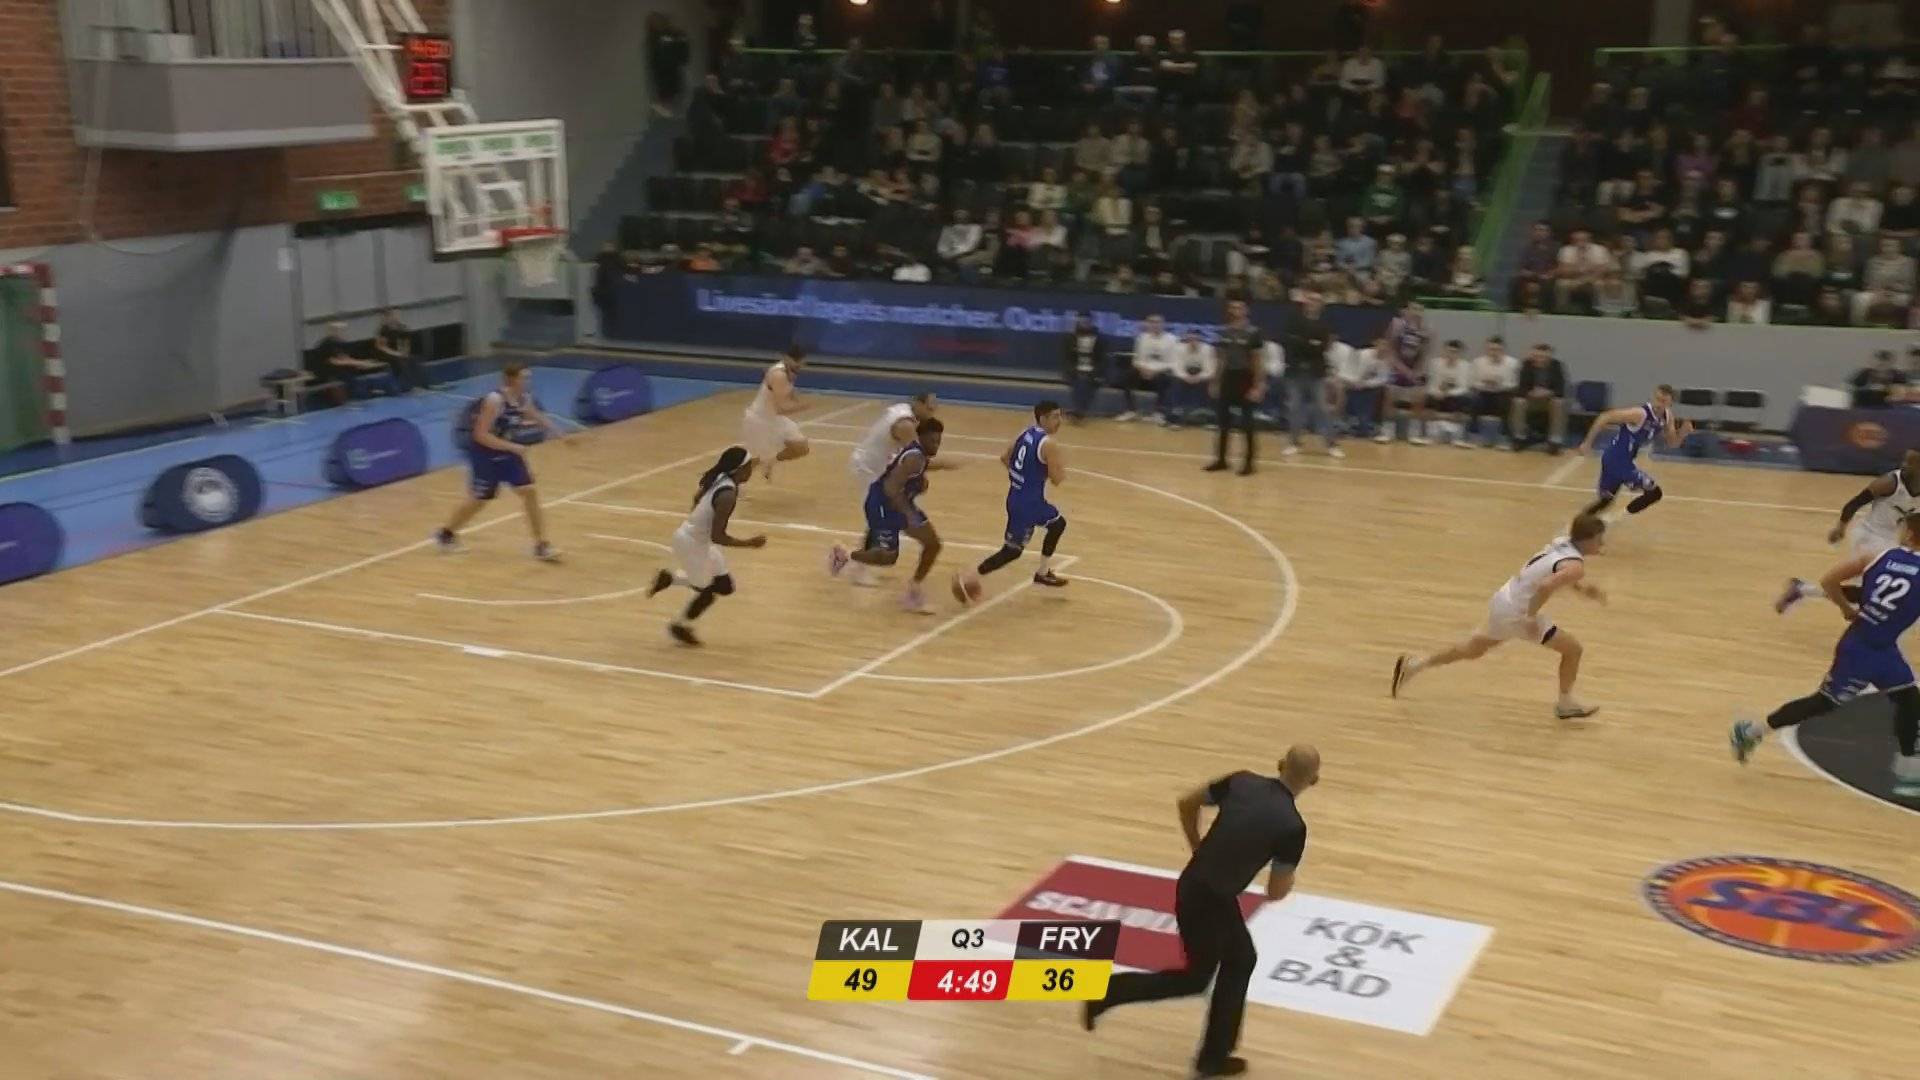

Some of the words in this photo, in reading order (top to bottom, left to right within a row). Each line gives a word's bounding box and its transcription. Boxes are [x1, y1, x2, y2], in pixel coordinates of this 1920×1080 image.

[1015, 445, 1027, 470] 9
[1870, 574, 1911, 610] 22
[1324, 946, 1366, 969] &
[1267, 959, 1392, 998] BAD
